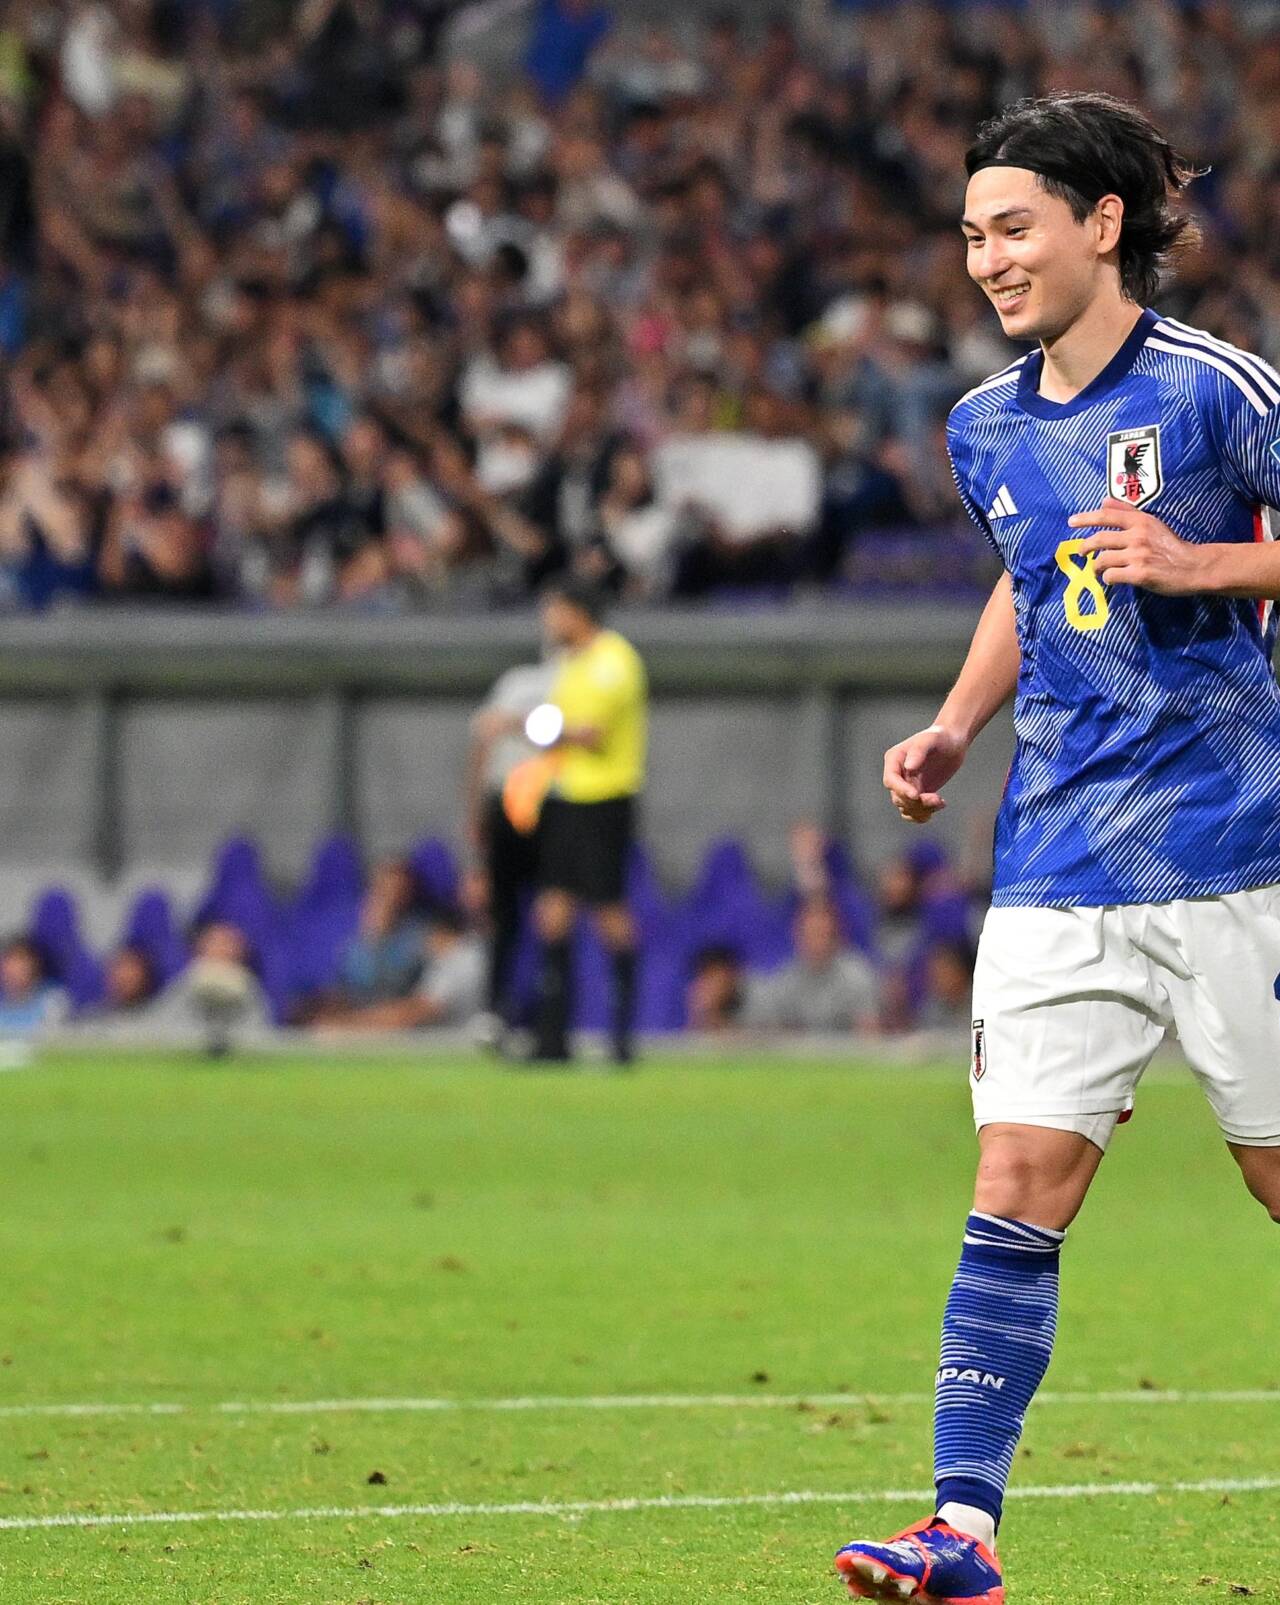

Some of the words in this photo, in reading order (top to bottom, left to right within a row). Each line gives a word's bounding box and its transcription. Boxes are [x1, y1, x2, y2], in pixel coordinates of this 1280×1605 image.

[1119, 430, 1146, 442] JAPAN
[1121, 483, 1146, 498] JFA
[1055, 539, 1109, 632] 8
[935, 1367, 1005, 1390] PAN
